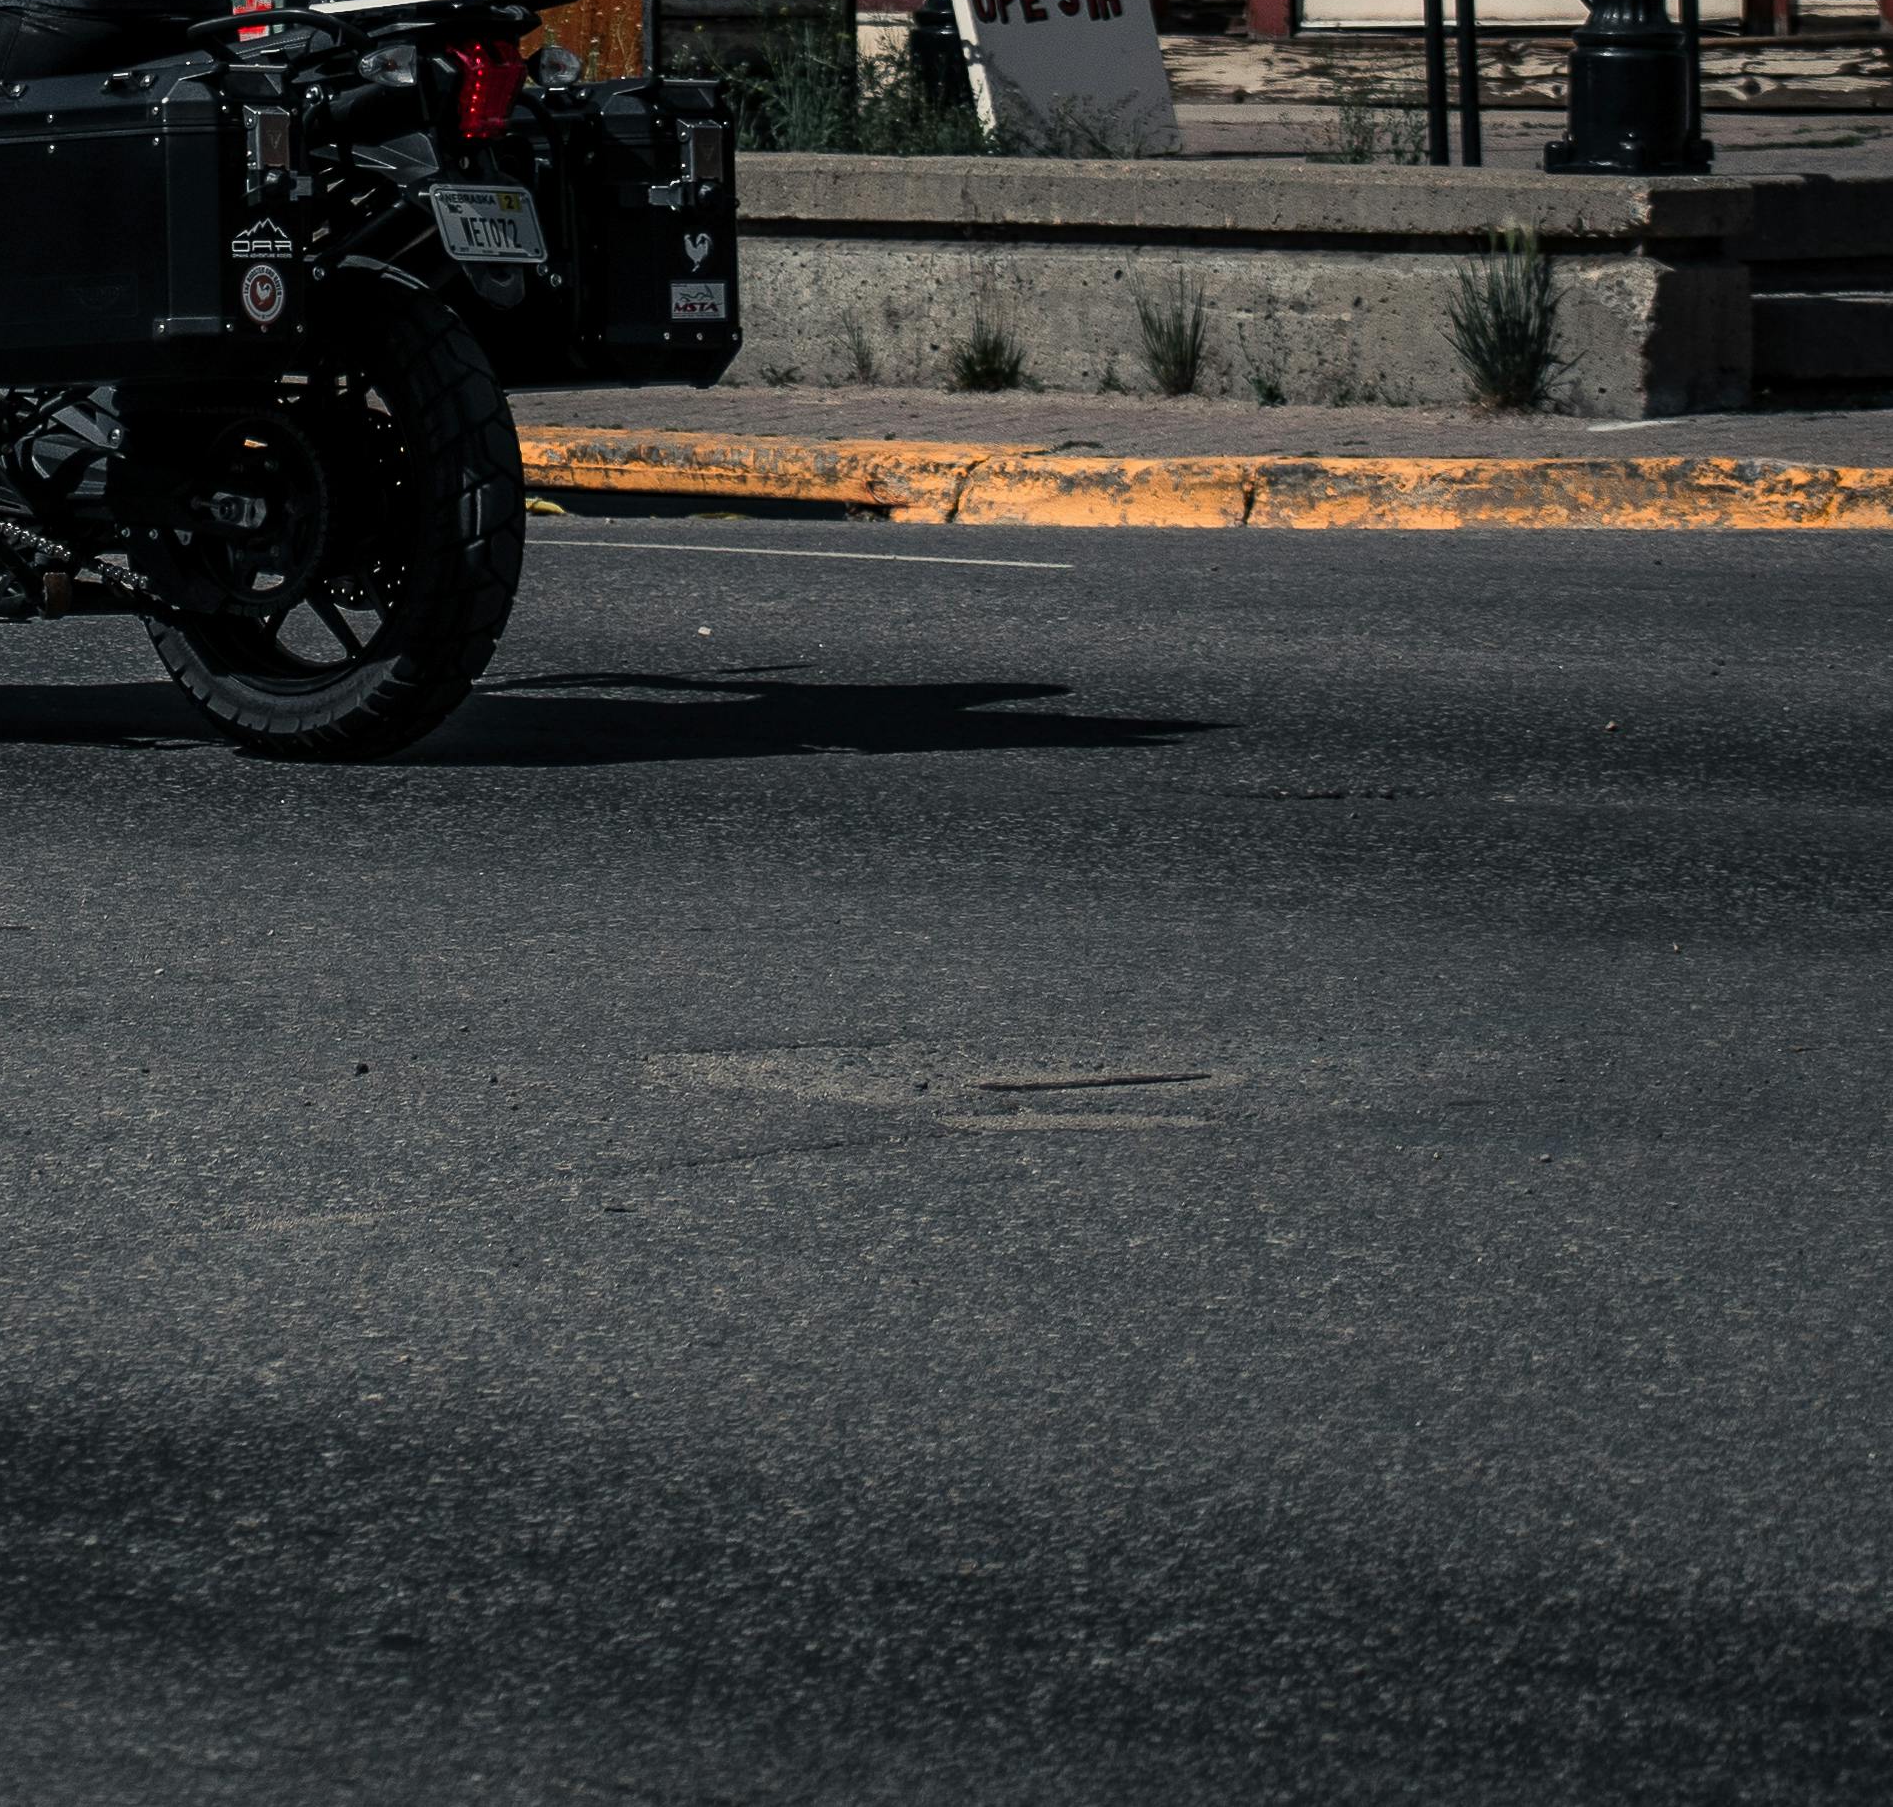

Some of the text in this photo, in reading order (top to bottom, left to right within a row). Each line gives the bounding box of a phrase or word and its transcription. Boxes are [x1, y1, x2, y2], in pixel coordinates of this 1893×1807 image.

[445, 193, 515, 209] NEBRASKA 2
[674, 302, 718, 313] MSTA
